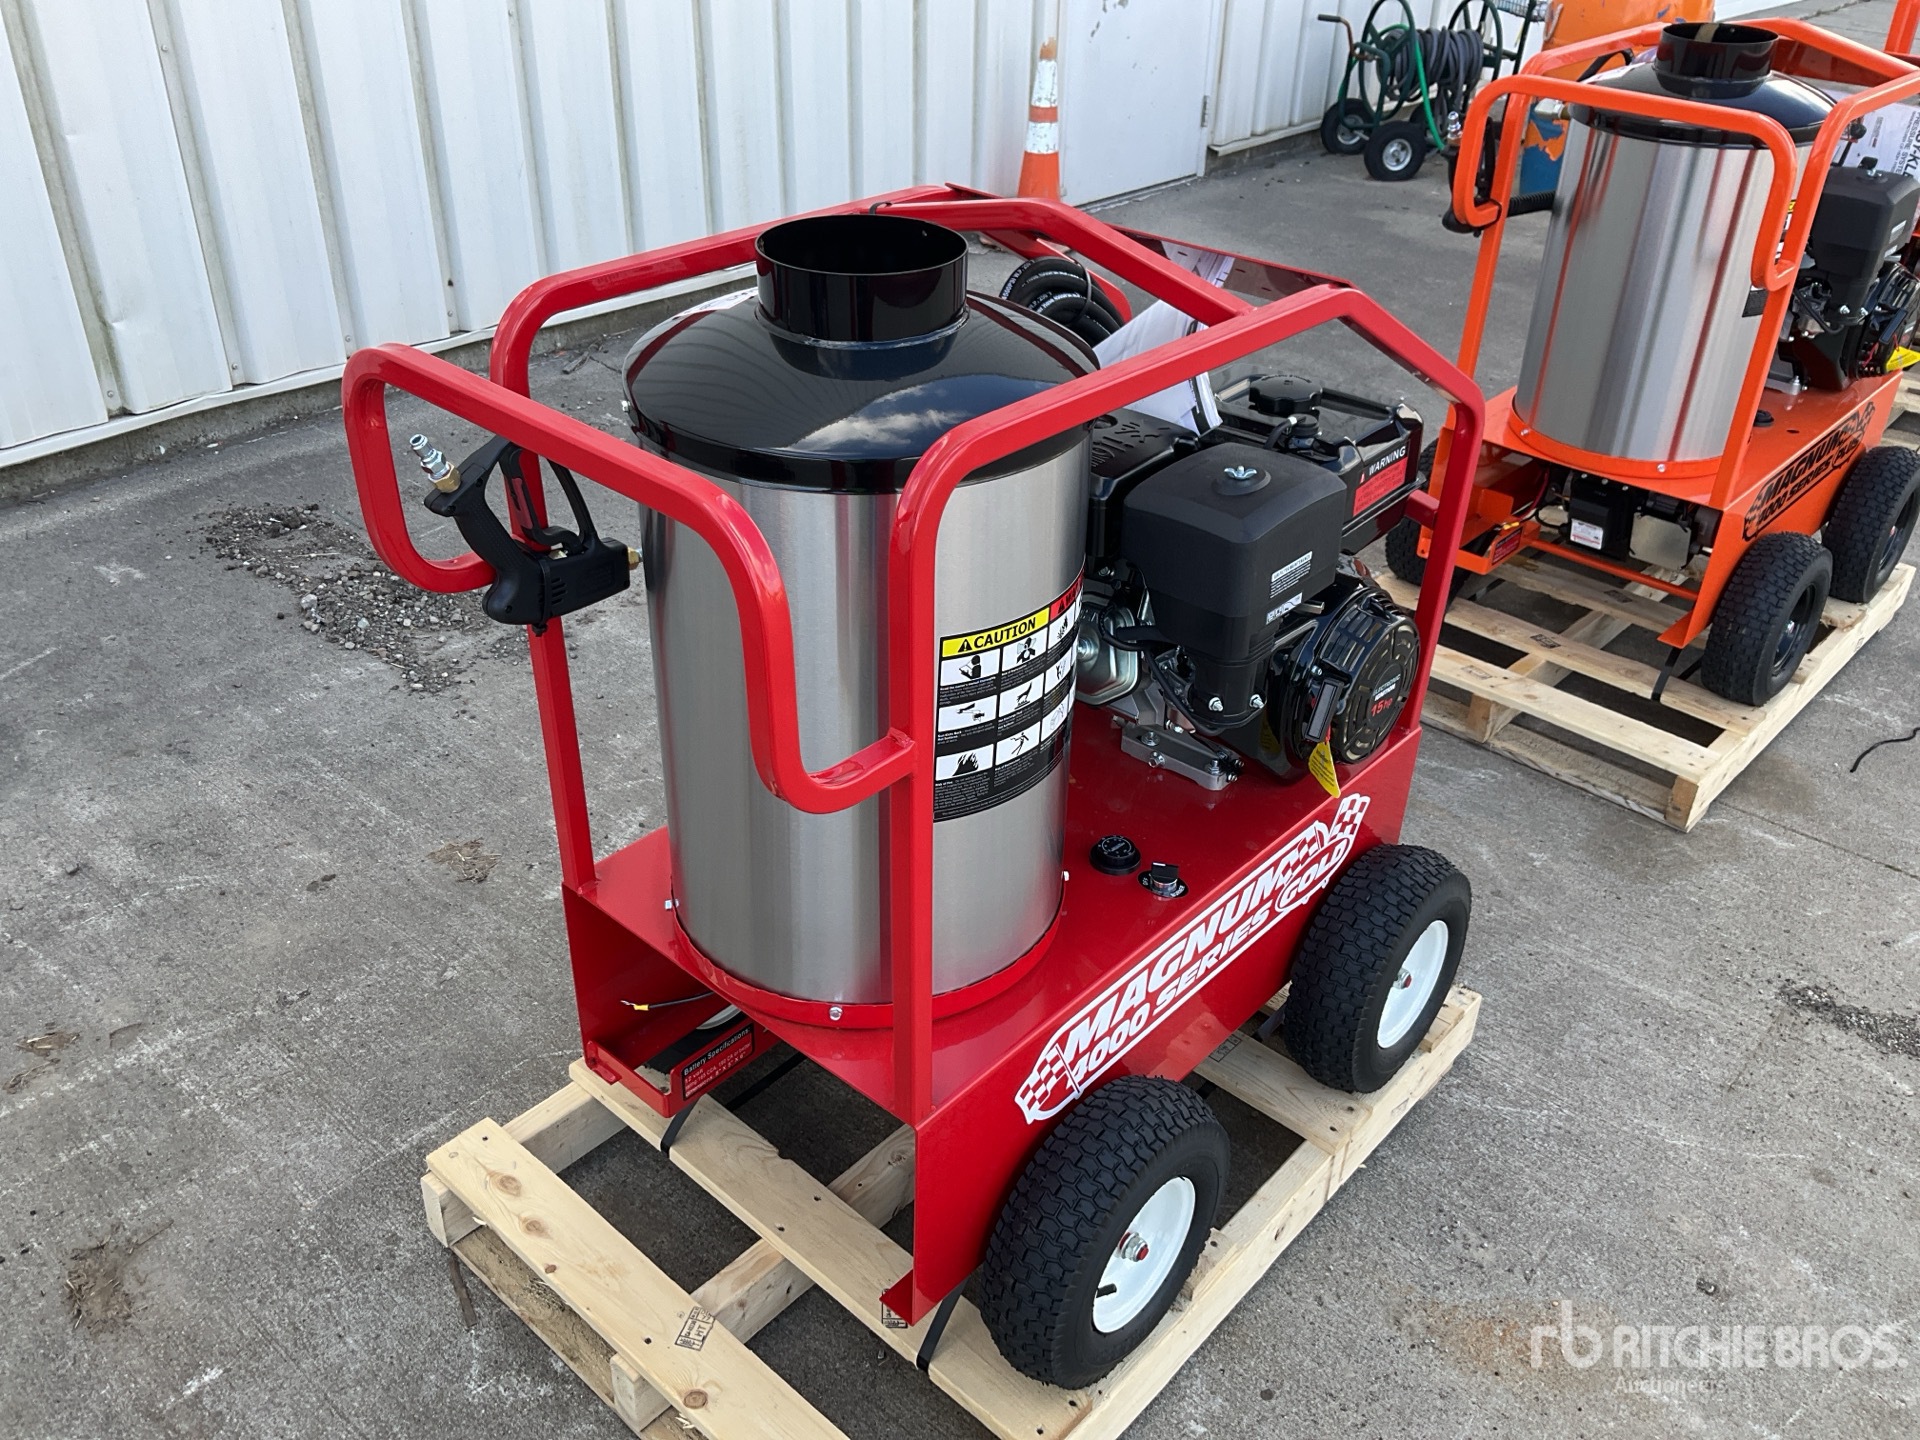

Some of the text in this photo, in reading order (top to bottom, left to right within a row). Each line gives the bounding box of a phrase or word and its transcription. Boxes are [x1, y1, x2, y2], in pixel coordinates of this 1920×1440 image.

[1369, 446, 1406, 475] WARNING
[1760, 430, 1842, 507] MAGNUM
[973, 617, 1036, 649] CAUTION
[1063, 866, 1277, 1066] MAGNUM
[1068, 838, 1347, 1083] 4000 SERIES GOLD
[683, 1056, 707, 1076] Battery
